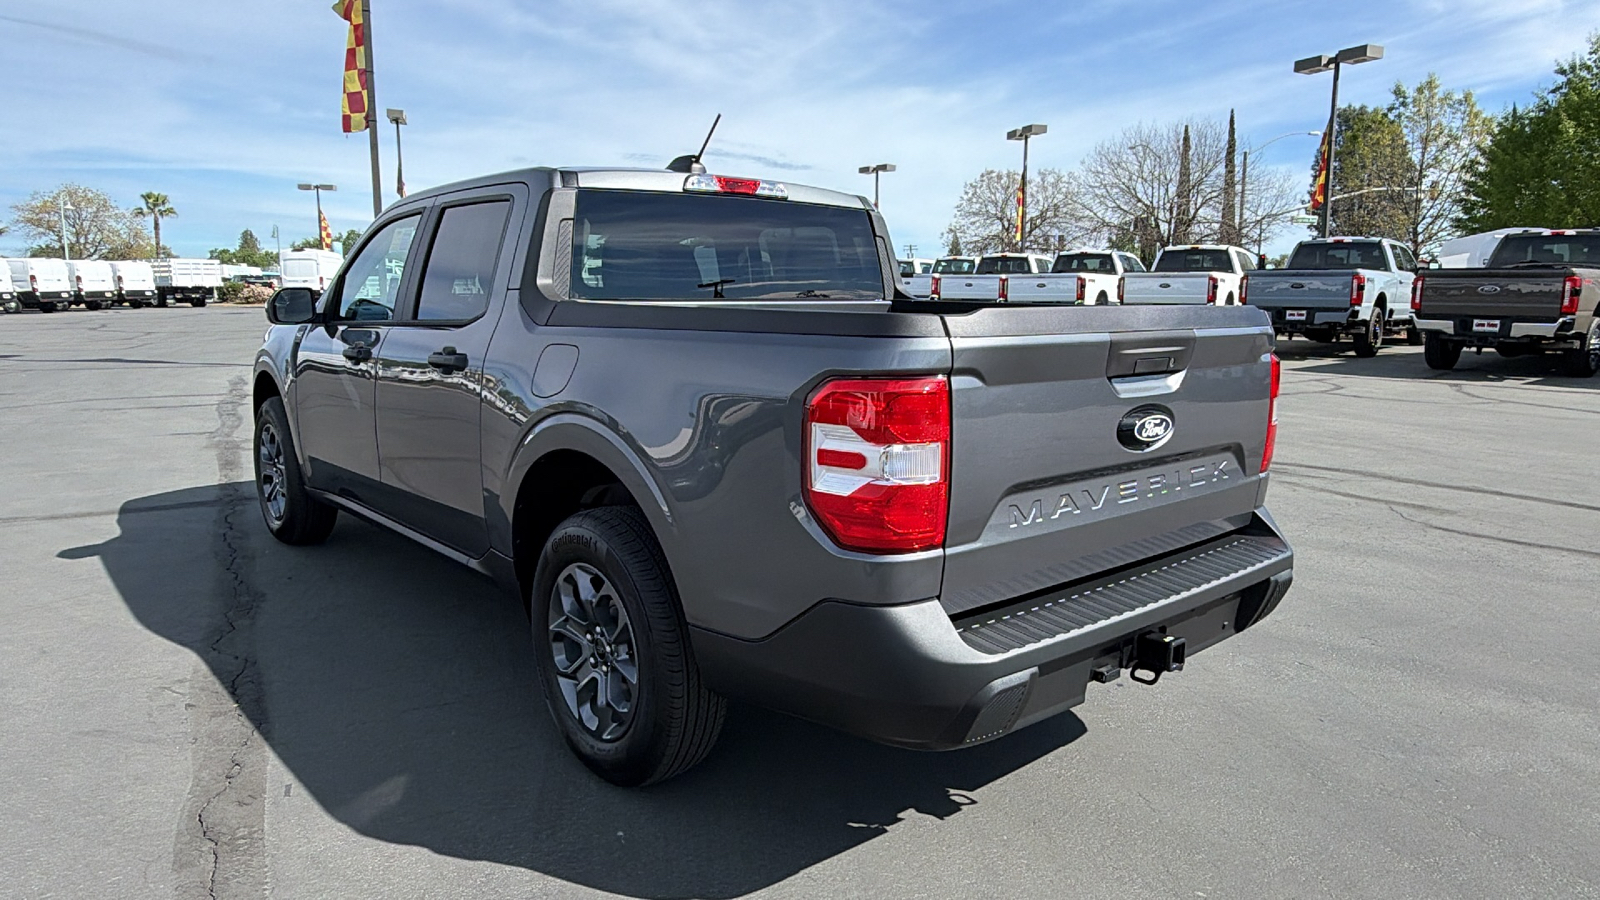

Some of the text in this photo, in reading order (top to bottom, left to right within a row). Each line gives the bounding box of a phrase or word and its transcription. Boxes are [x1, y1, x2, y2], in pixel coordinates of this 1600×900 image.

[1142, 419, 1166, 437] Ford
[1008, 460, 1229, 528] MAVERICK
[552, 532, 592, 552] Continental
